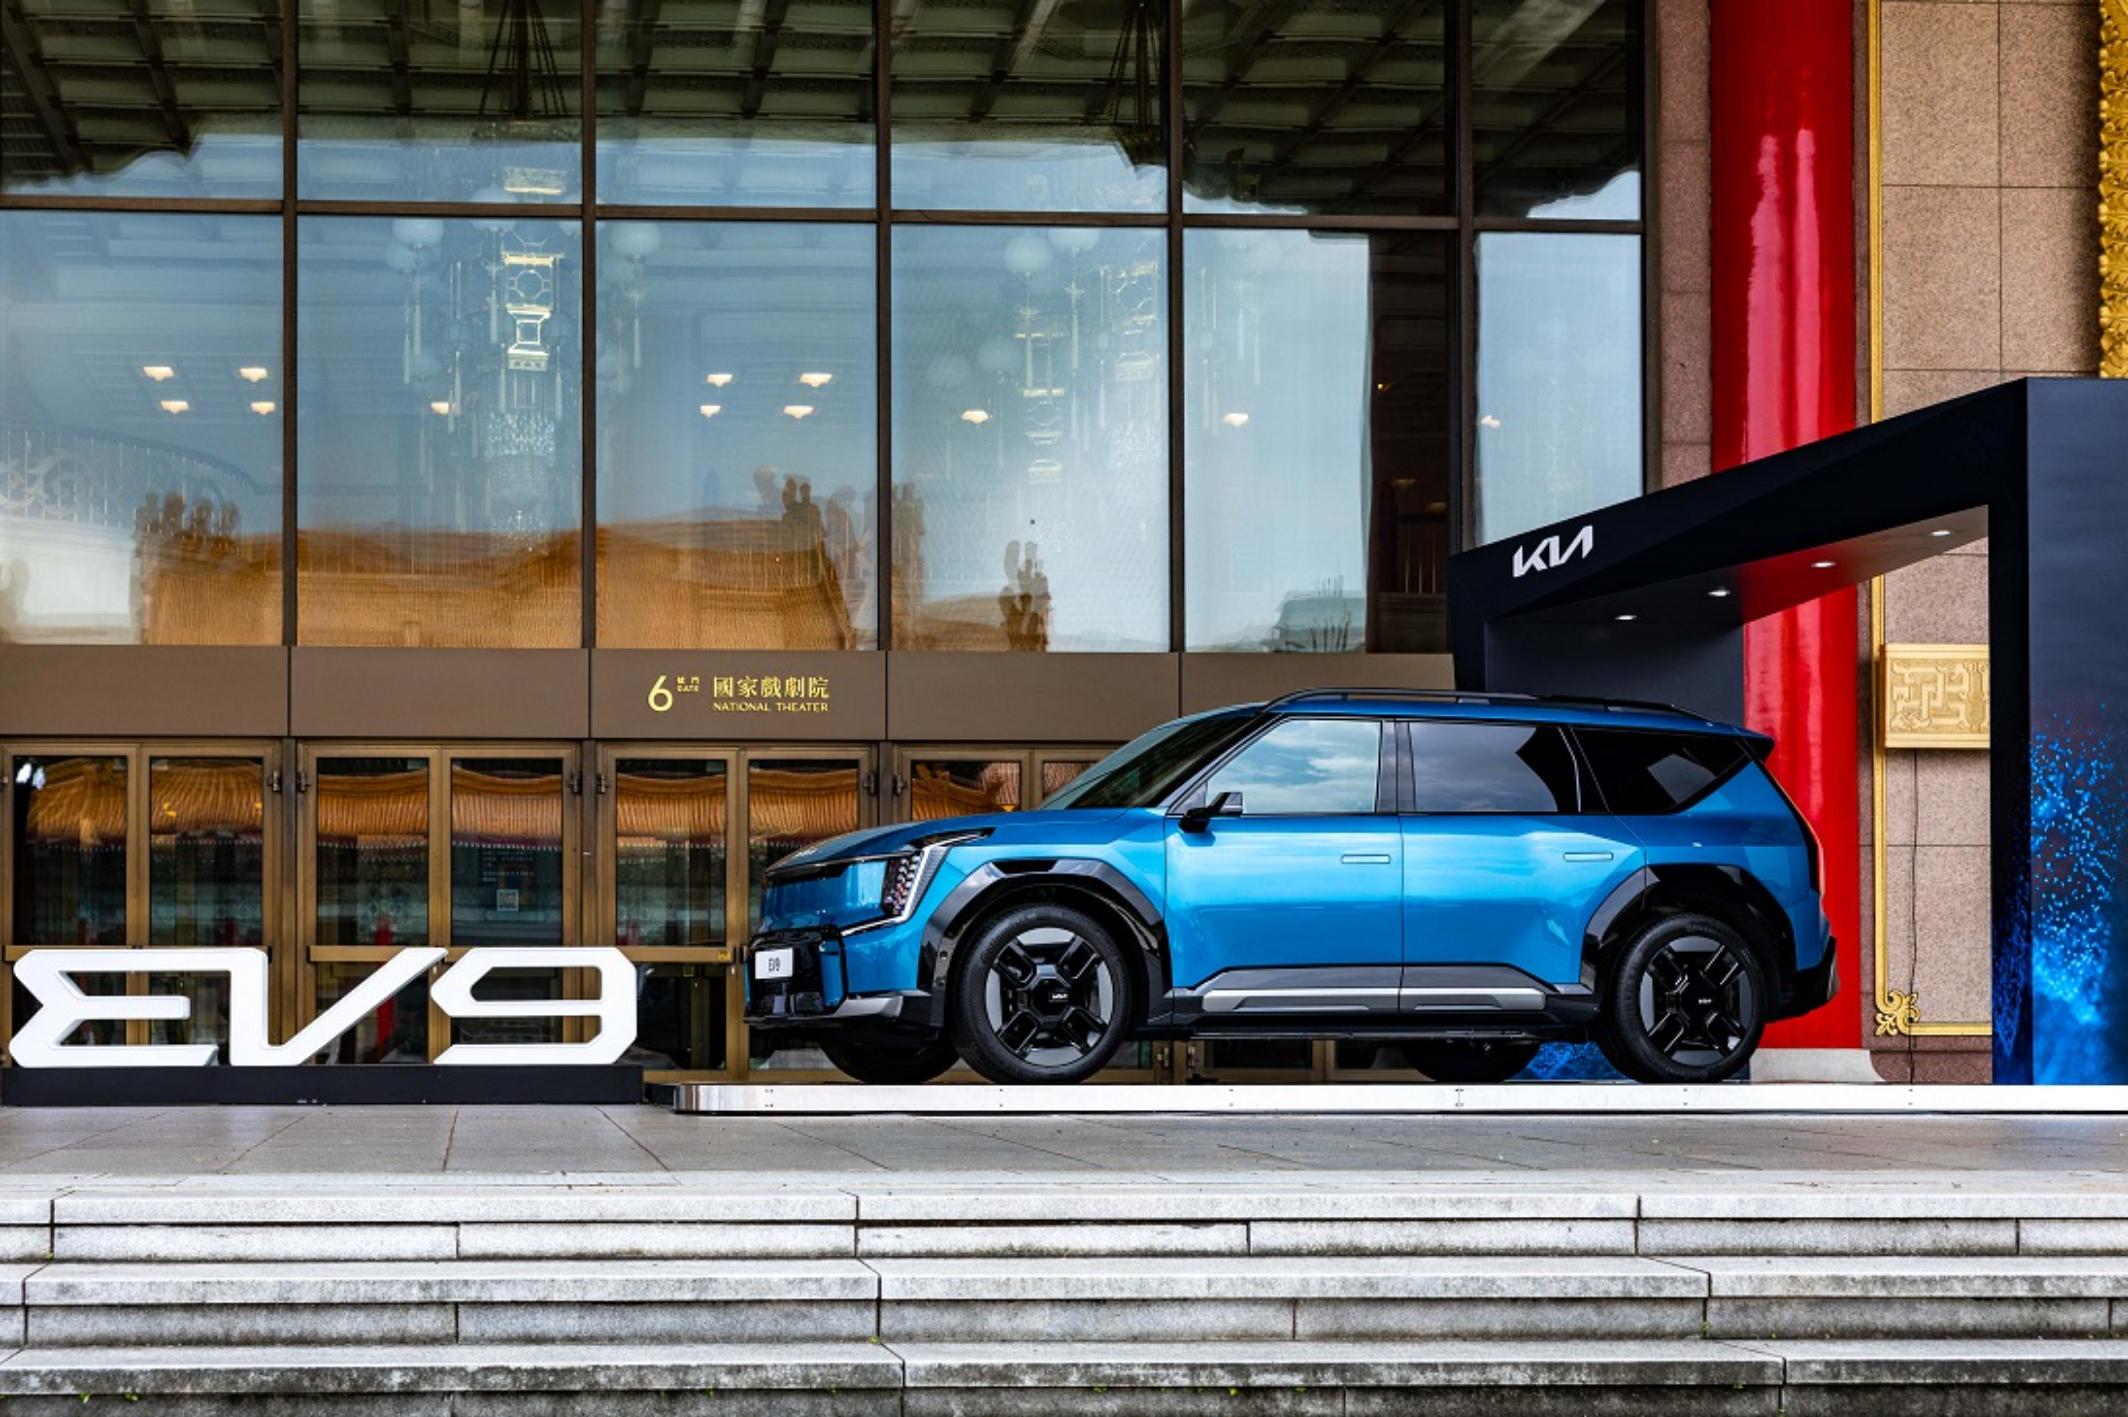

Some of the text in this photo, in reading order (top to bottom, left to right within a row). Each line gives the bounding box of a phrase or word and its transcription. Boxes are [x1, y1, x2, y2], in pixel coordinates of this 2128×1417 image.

[1512, 525, 1593, 578] KIA
[648, 675, 674, 712] 6
[713, 675, 829, 698] 國家戲劇院
[713, 701, 829, 712] NATIONAL THEATER
[9, 947, 637, 1067] EV9
